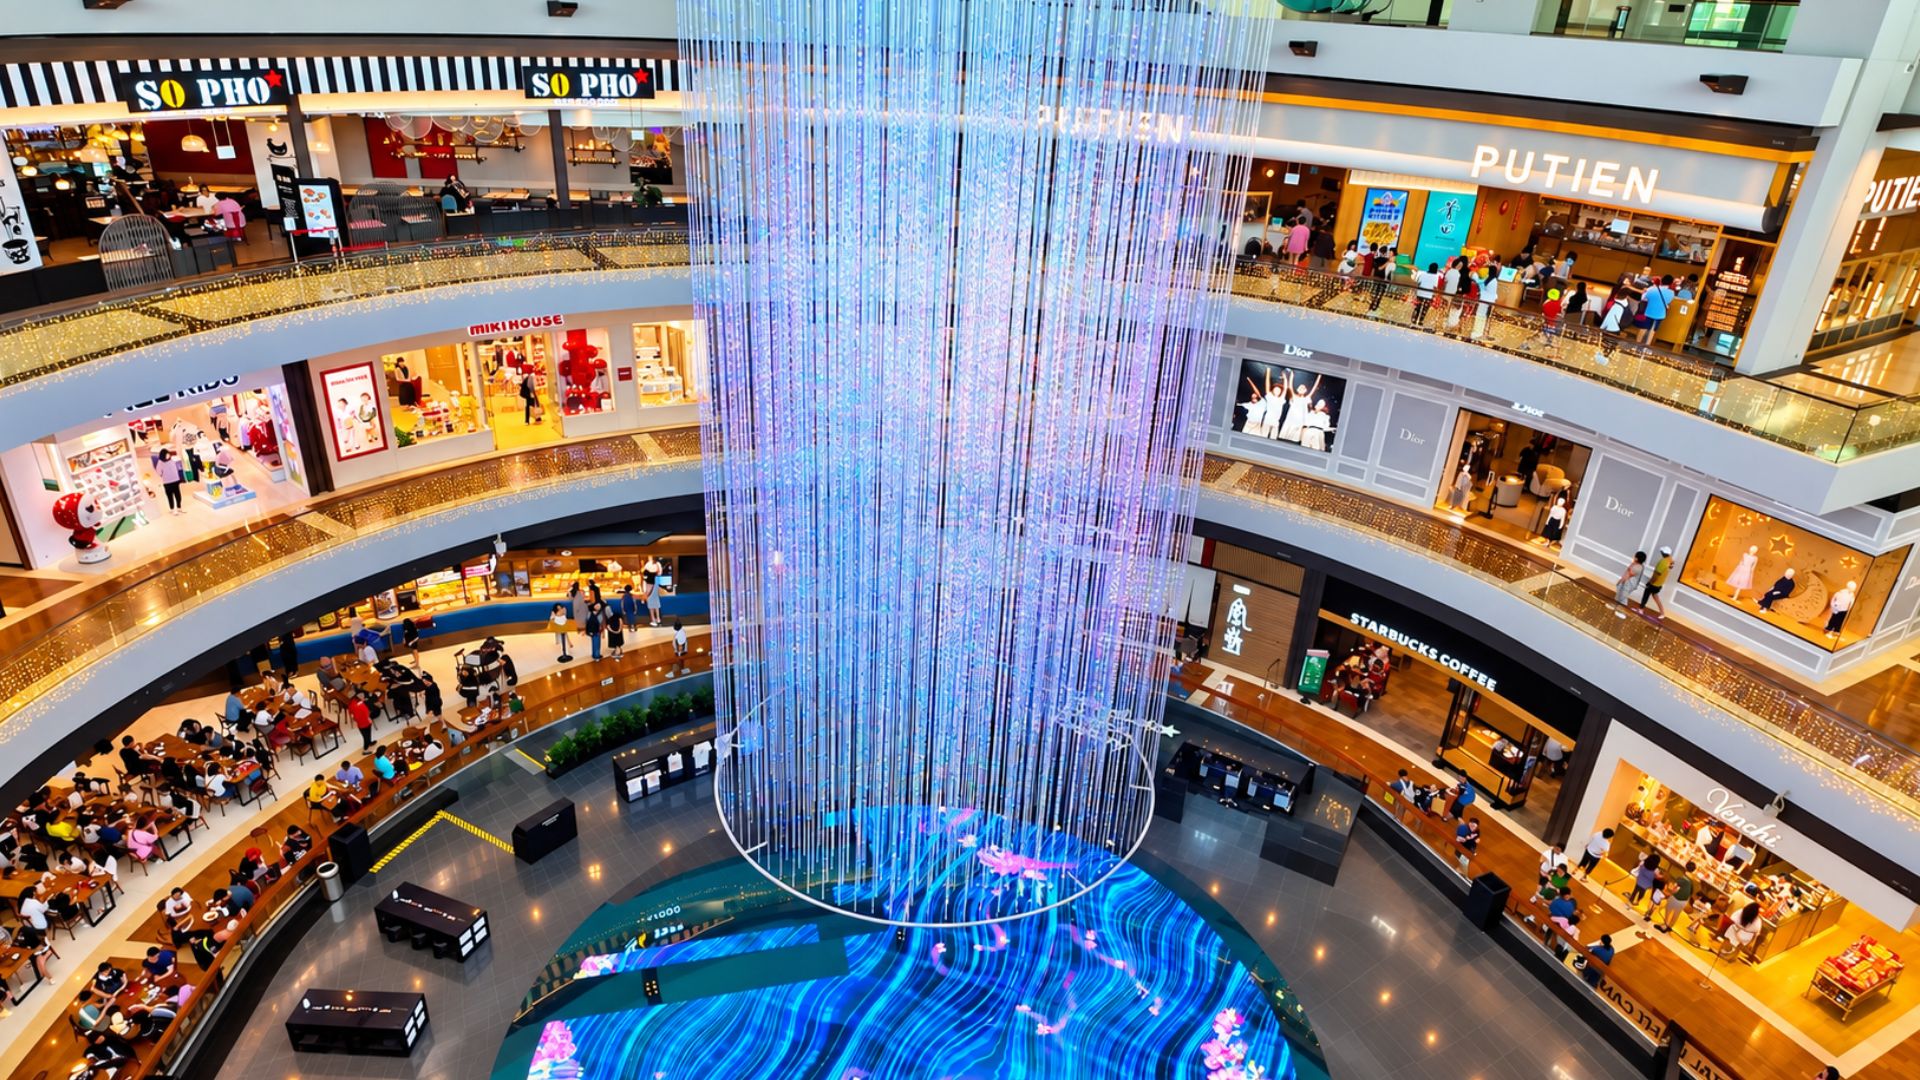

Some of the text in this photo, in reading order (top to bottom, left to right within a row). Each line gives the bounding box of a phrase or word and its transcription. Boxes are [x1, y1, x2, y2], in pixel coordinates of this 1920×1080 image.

[135, 76, 271, 111] SO PHO
[532, 73, 638, 98] SO PHO
[1470, 145, 1660, 205] PUTIEN
[469, 314, 563, 336] MIKI HOUSE
[1283, 343, 1314, 359] Dior
[1400, 427, 1426, 446] Dior
[1605, 495, 1635, 518] Dior
[1350, 612, 1499, 692] STARBUCKS COFFEE
[1706, 787, 1782, 848] Venchi
